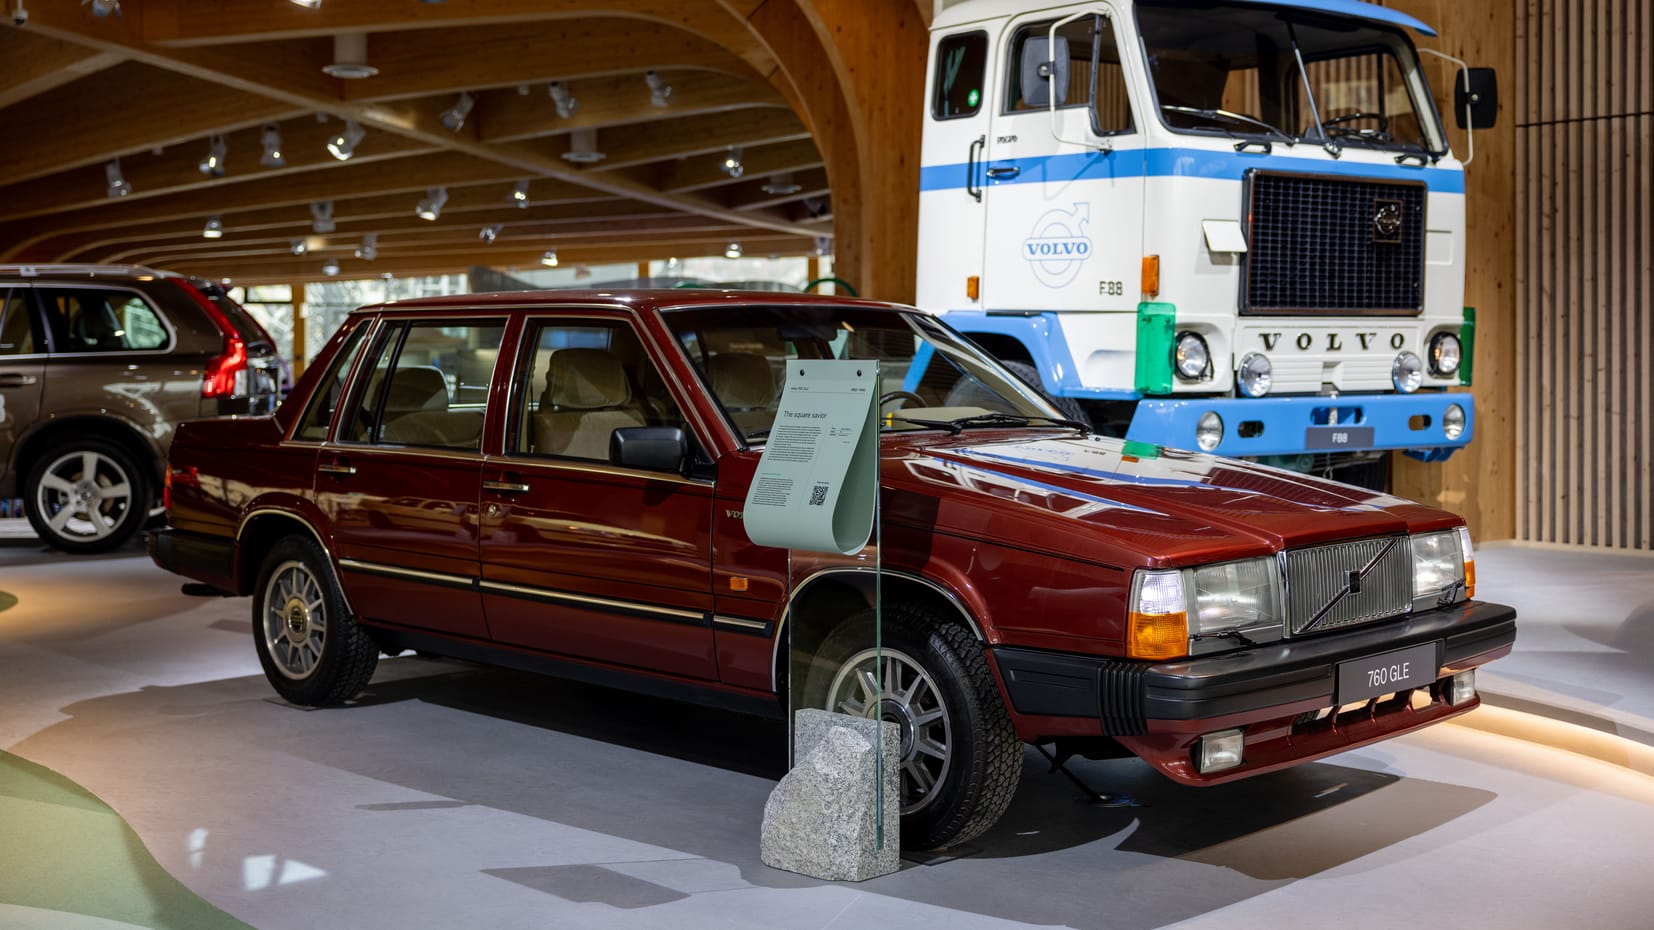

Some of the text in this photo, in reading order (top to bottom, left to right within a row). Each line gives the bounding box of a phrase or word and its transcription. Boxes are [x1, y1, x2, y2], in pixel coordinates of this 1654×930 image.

[1026, 241, 1088, 255] VOLVO
[1099, 281, 1123, 295] F88
[1258, 332, 1405, 351] VOLVO
[784, 410, 793, 418] The
[1332, 432, 1348, 443] F88
[1367, 662, 1410, 688] 760 GLE
